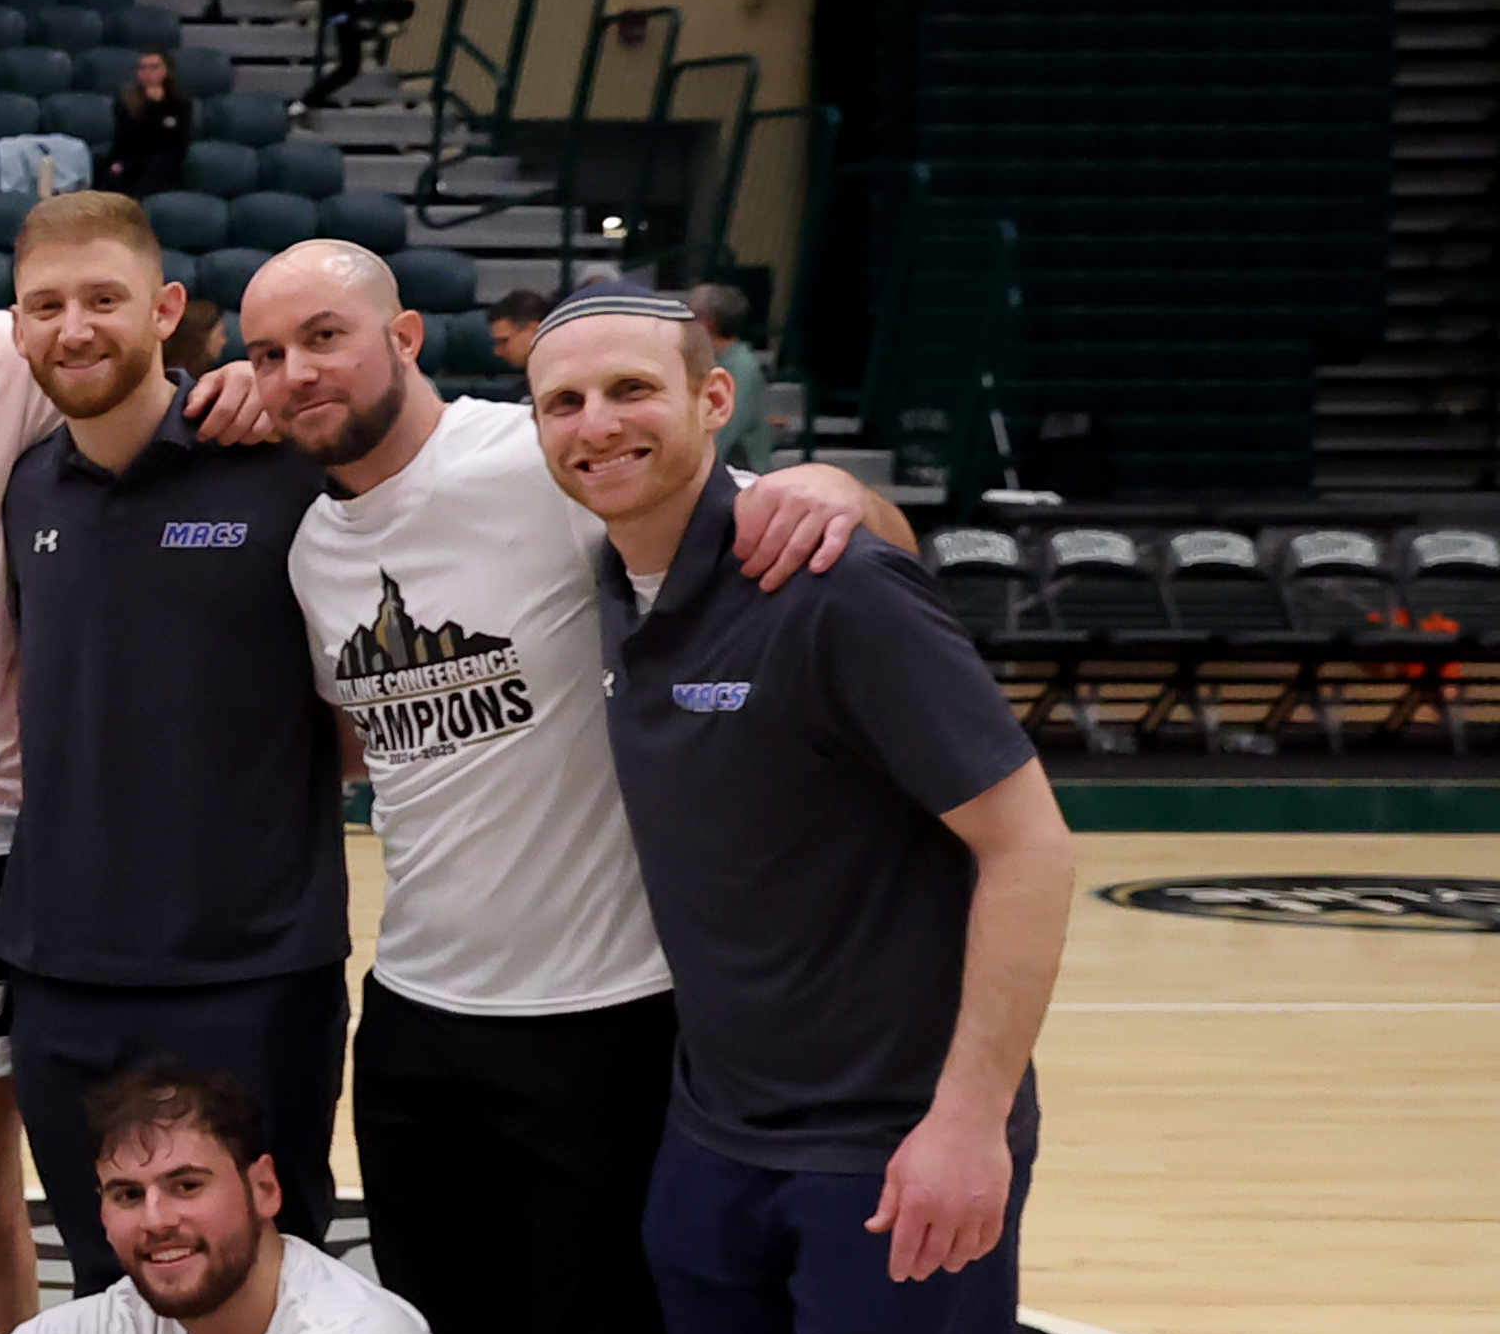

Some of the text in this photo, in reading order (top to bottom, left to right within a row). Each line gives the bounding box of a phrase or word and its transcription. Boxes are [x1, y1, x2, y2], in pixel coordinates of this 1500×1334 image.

[160, 521, 249, 548] MACS
[383, 647, 520, 695] CONFERENCE
[672, 681, 752, 713] MACS
